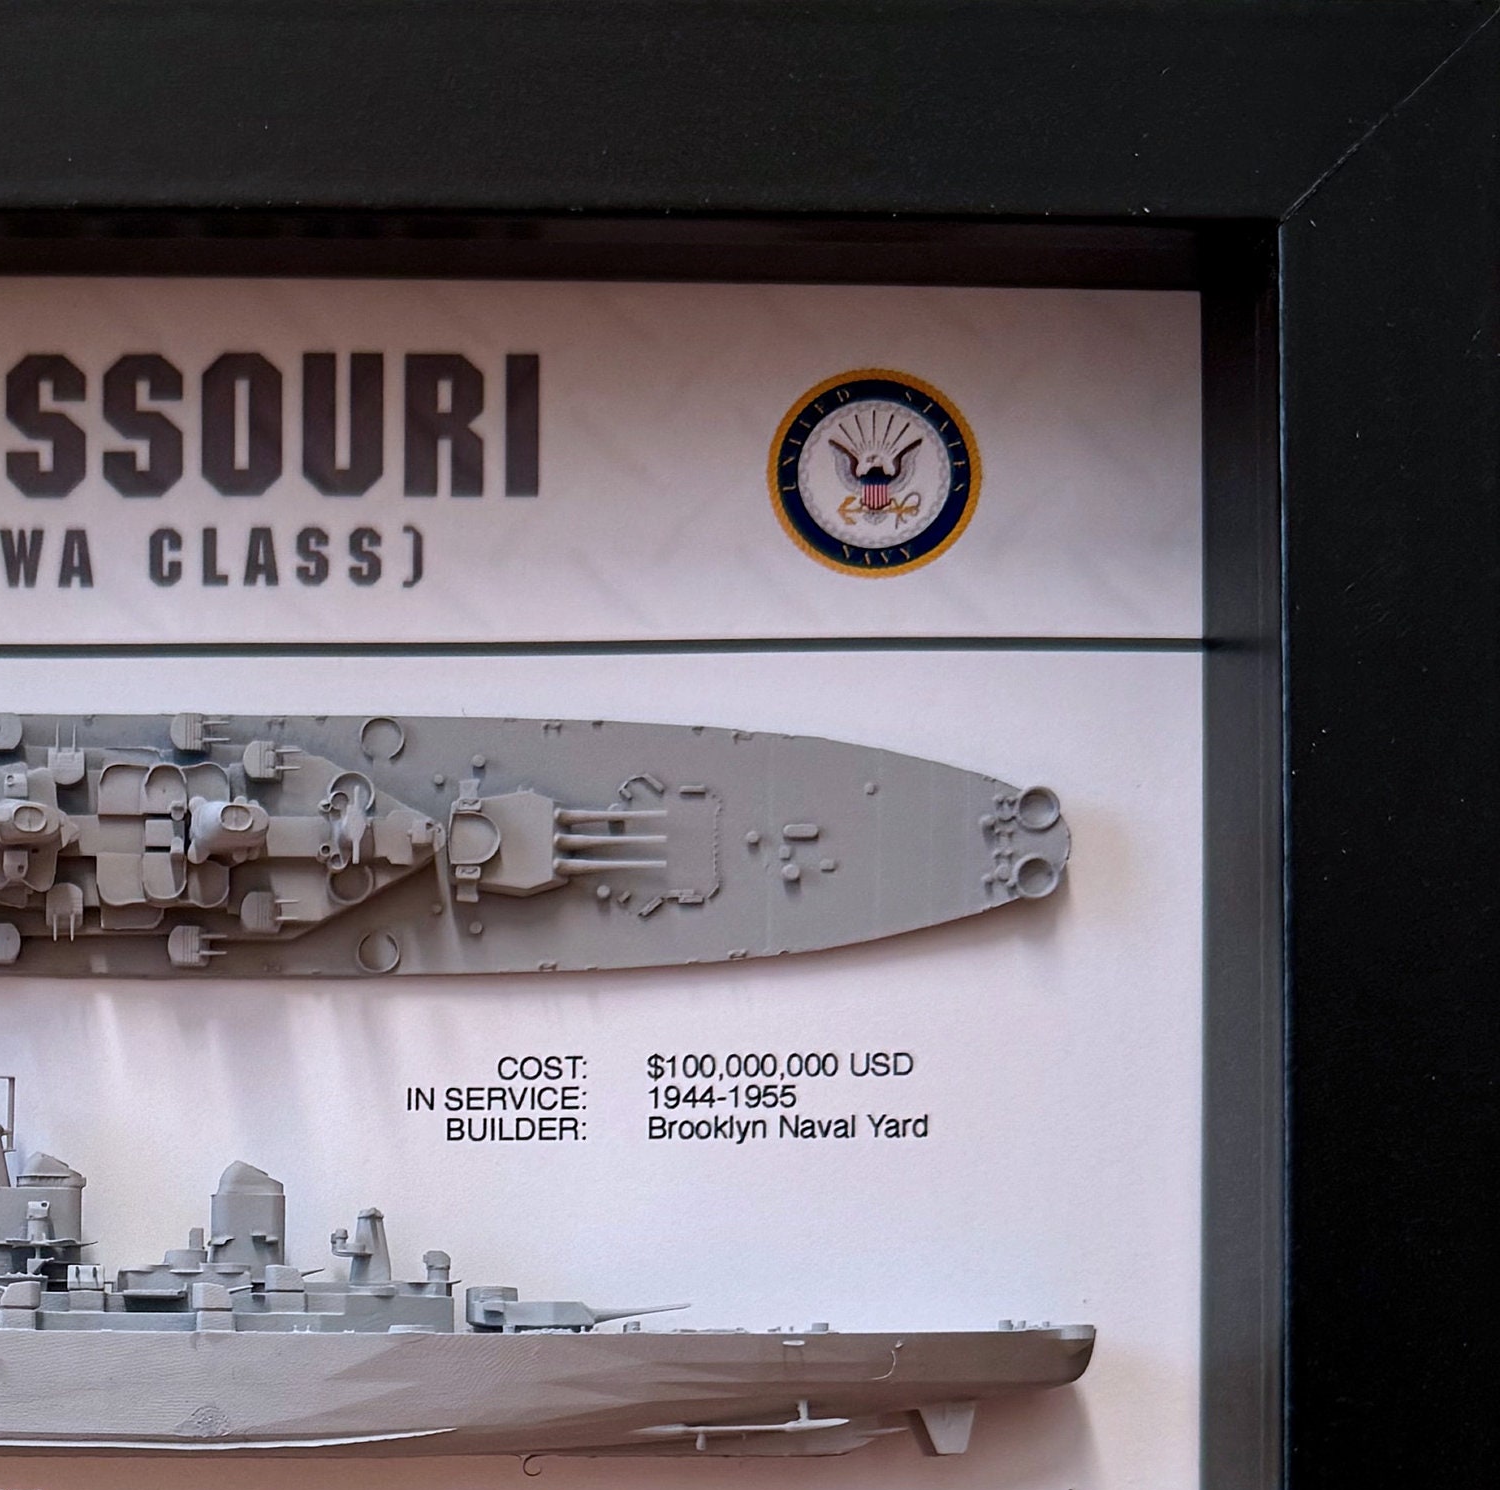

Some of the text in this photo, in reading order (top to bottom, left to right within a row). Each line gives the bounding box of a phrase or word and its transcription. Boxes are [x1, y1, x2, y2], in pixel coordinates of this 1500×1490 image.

[148, 522, 425, 589] CLASS)
[498, 1051, 914, 1082] COST: $100,000,000 USD
[406, 1084, 798, 1112] IN SERVICE: 1944-1955
[446, 1113, 929, 1145] BUILDER: Brooklyn Naval Yard
